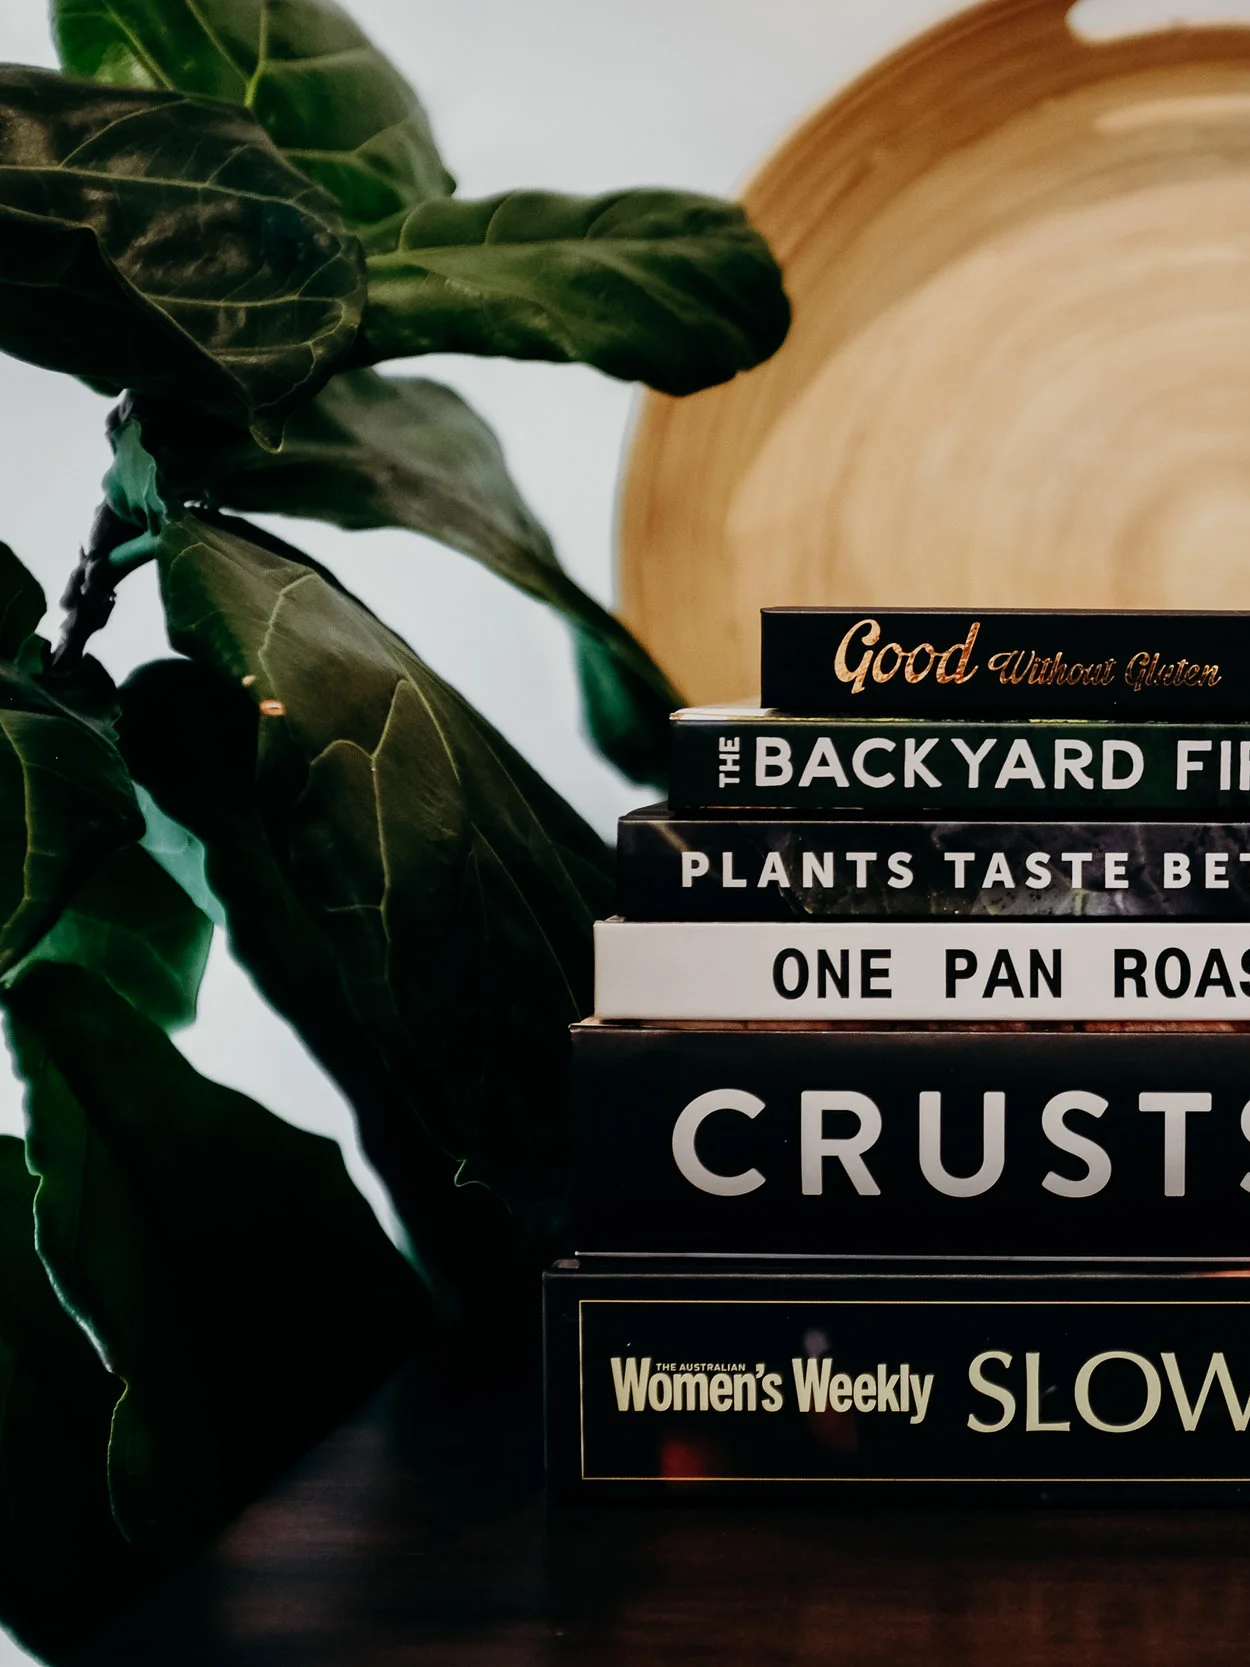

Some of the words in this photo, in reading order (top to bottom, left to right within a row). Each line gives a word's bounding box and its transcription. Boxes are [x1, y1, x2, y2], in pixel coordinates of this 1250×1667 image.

[833, 618, 981, 694] Good
[987, 650, 1115, 686] Without
[718, 736, 741, 789] THE
[755, 736, 1145, 790] BACKYARD
[681, 850, 914, 889] PLANTS
[944, 852, 1130, 889] TASTE
[772, 947, 893, 1000] ONE
[945, 948, 1062, 999] PAN
[610, 1356, 784, 1413] Women's
[791, 1356, 935, 1425] Weekly
[655, 1362, 677, 1372] THE
[678, 1363, 746, 1372] AUSTRALIAN
